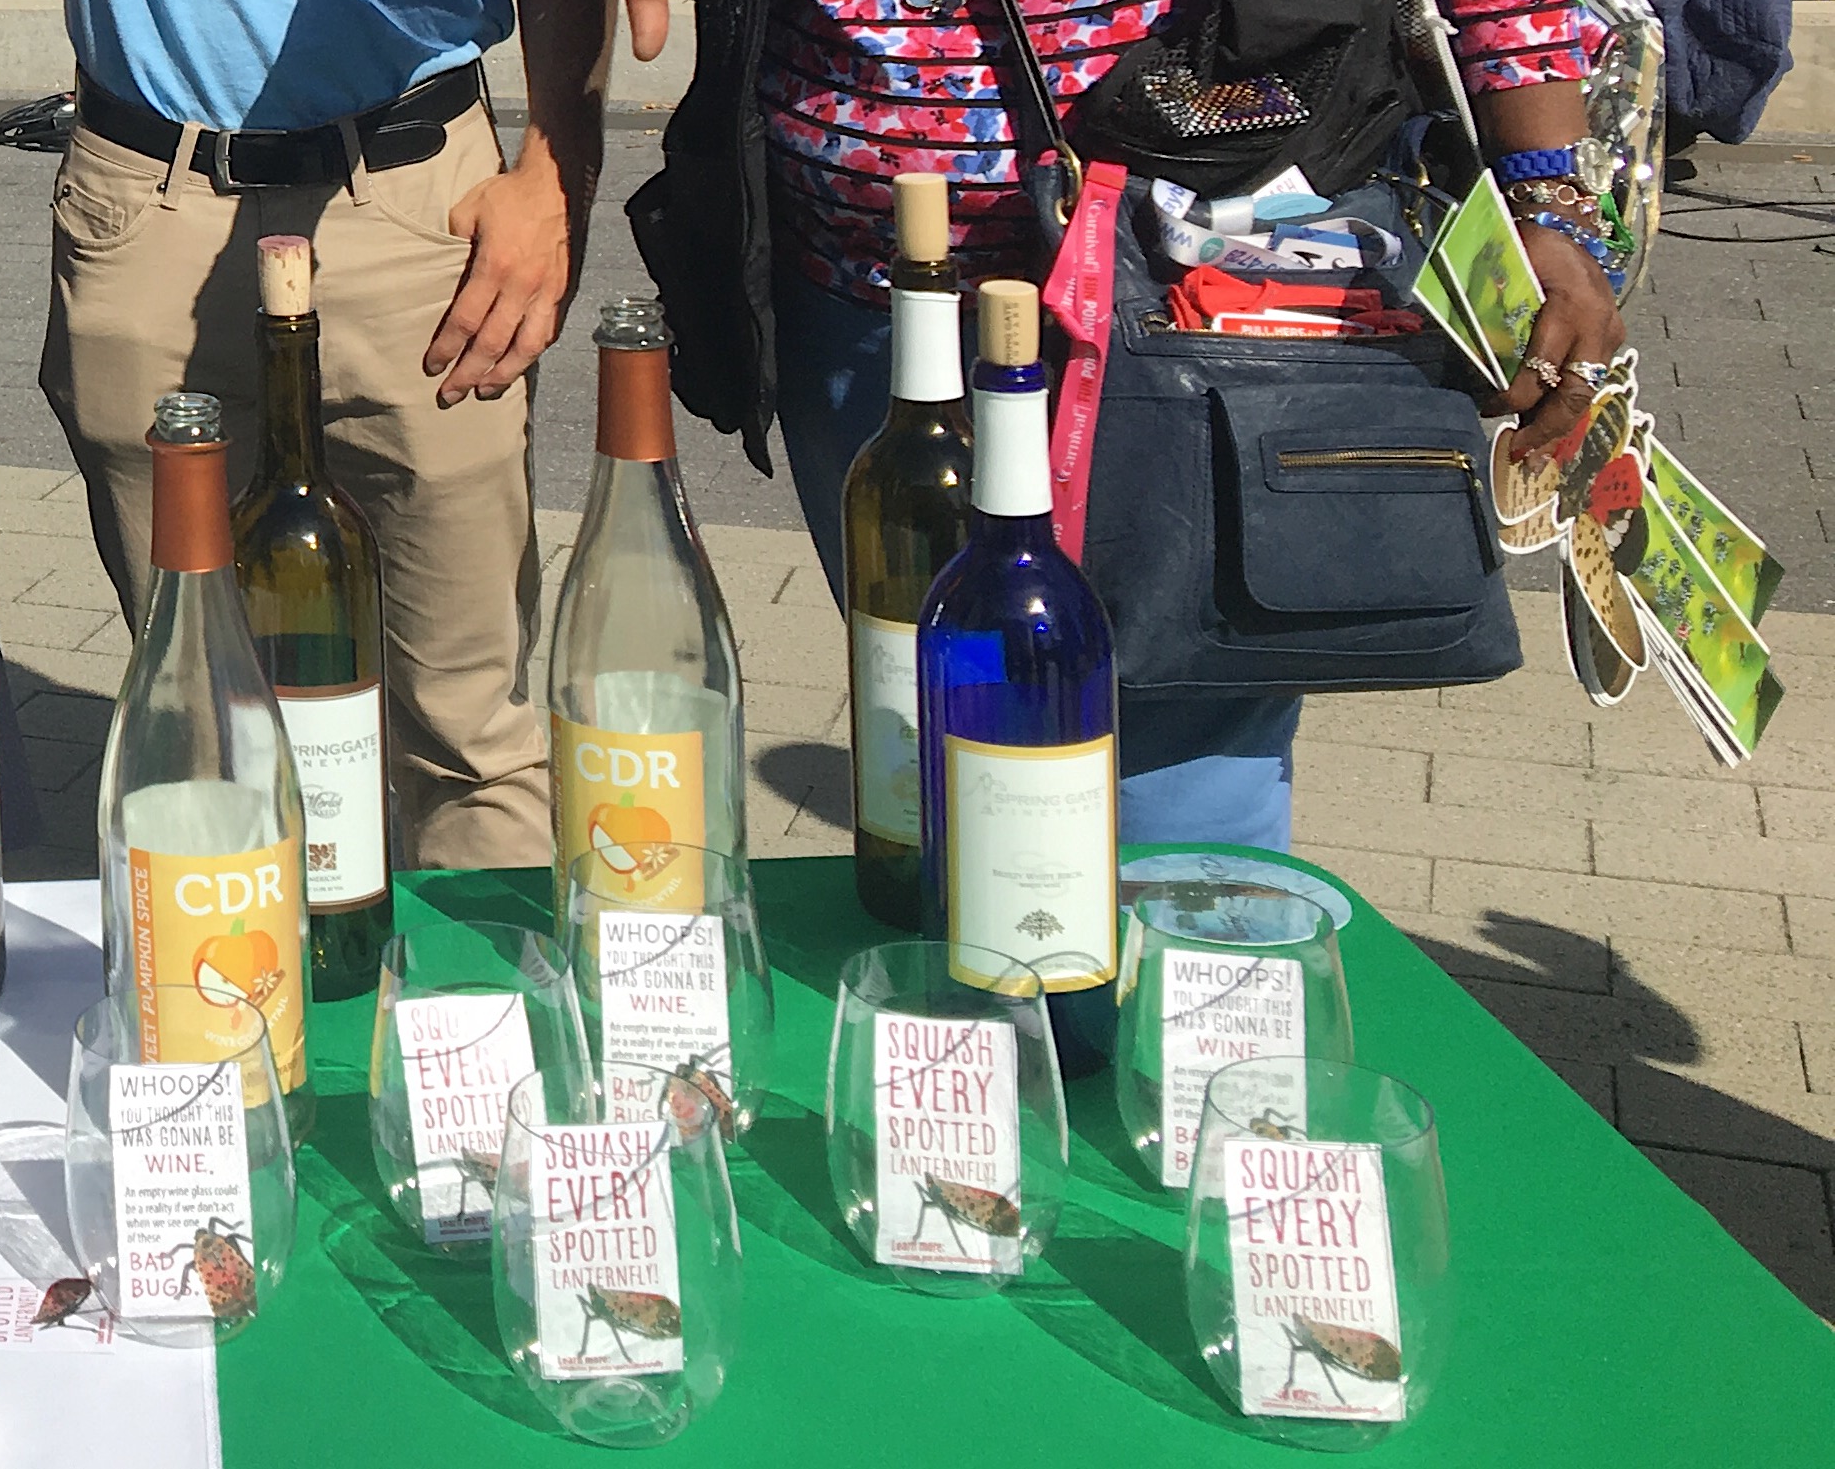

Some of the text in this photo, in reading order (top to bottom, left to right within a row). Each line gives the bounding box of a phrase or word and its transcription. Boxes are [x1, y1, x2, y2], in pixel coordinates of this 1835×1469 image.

[342, 733, 377, 754] GATE
[575, 742, 680, 789] CDR
[175, 864, 284, 916] CDR
[135, 867, 155, 1015] PUMPKIN SPICE
[606, 923, 713, 946] WHOOPS!
[689, 953, 715, 969] THIS
[608, 970, 714, 991] WAS GONNA BE
[1173, 961, 1292, 993] WHOOPS!
[630, 994, 695, 1016] WINE.
[1265, 998, 1293, 1018] THIS
[1214, 1015, 1269, 1038] GONNA
[1275, 1019, 1292, 1040] BE
[888, 1021, 994, 1067] SQUASH
[119, 1074, 231, 1097] WHOOPS!
[613, 1076, 653, 1102] BAD
[889, 1065, 994, 1117] EVERY
[147, 1105, 201, 1123] THOUGHT
[206, 1104, 233, 1122] THIS
[121, 1125, 234, 1147] WAS GONNA BE
[888, 1115, 997, 1157] SPOTTED
[544, 1130, 651, 1171] SQUASH
[145, 1154, 214, 1175] WINE.
[890, 1153, 997, 1183] LANTERNFLY!
[1241, 1148, 1361, 1195] SQUASH
[124, 1184, 238, 1199] An empty wine glass could
[547, 1169, 651, 1224] EVERY
[125, 1203, 136, 1214] be
[145, 1202, 172, 1215] reality
[126, 1219, 199, 1228] when we see one
[1245, 1196, 1361, 1249] EVERY
[137, 1234, 161, 1243] these
[549, 1225, 657, 1264] SPOTTED
[130, 1252, 174, 1271] BAD
[1249, 1252, 1371, 1292] SPOTTED
[552, 1263, 659, 1290] LANTERNFLY!
[1253, 1294, 1374, 1322] LANTERNFLY!
